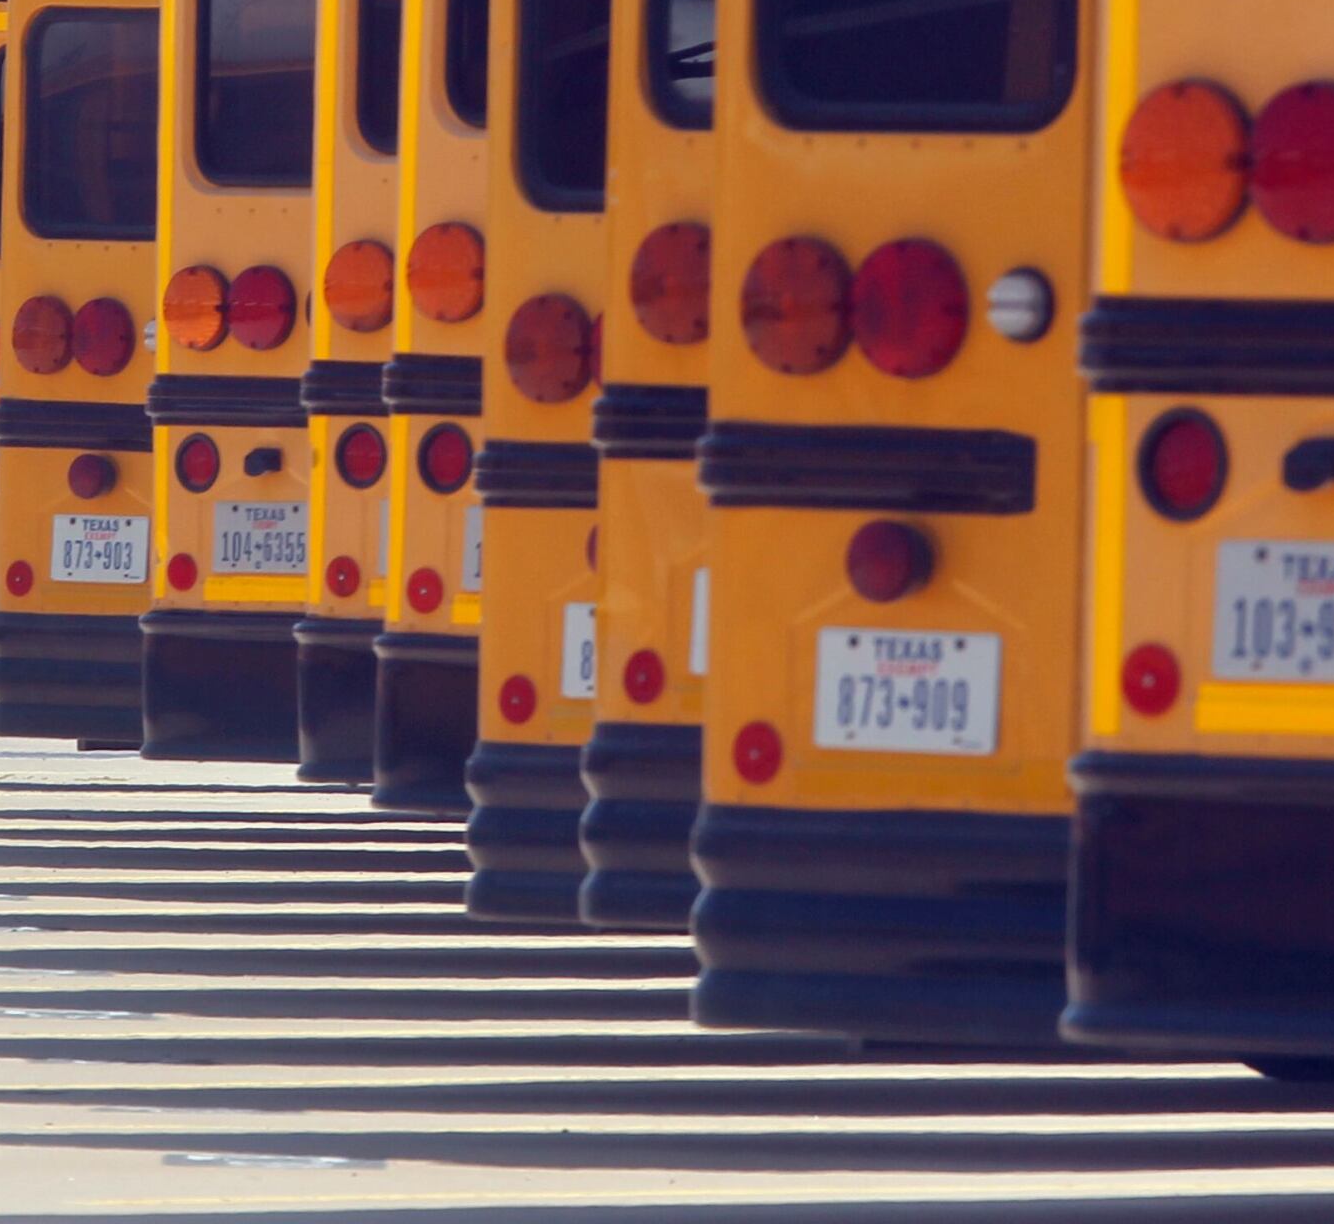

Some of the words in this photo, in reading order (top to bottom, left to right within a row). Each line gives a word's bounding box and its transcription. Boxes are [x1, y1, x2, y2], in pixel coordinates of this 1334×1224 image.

[246, 507, 286, 521] TEXAS
[82, 519, 120, 532] TEXAS
[873, 636, 944, 662] TEXAS
